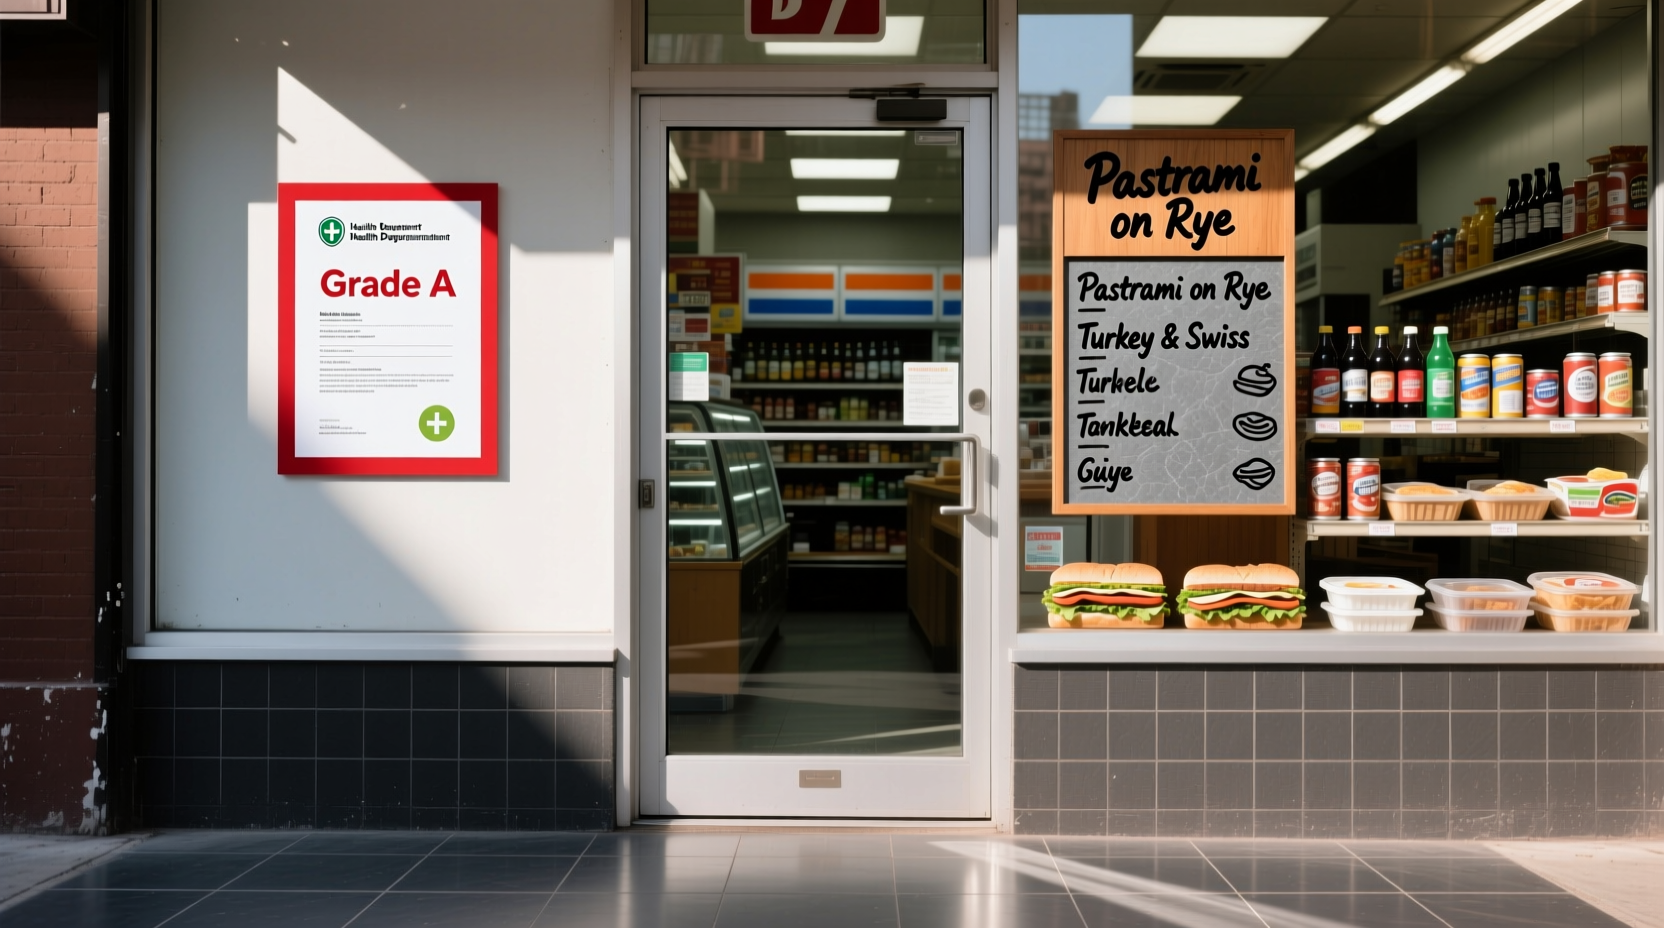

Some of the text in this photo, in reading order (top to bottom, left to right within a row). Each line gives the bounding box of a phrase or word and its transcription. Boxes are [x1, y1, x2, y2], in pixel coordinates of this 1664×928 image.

[1084, 151, 1262, 205] Pastrami
[1110, 196, 1236, 251] on Rye
[320, 268, 456, 298] Grade A
[1077, 270, 1272, 311] Pastrami on Rye
[1077, 321, 1250, 360] Turkey & Swiss
